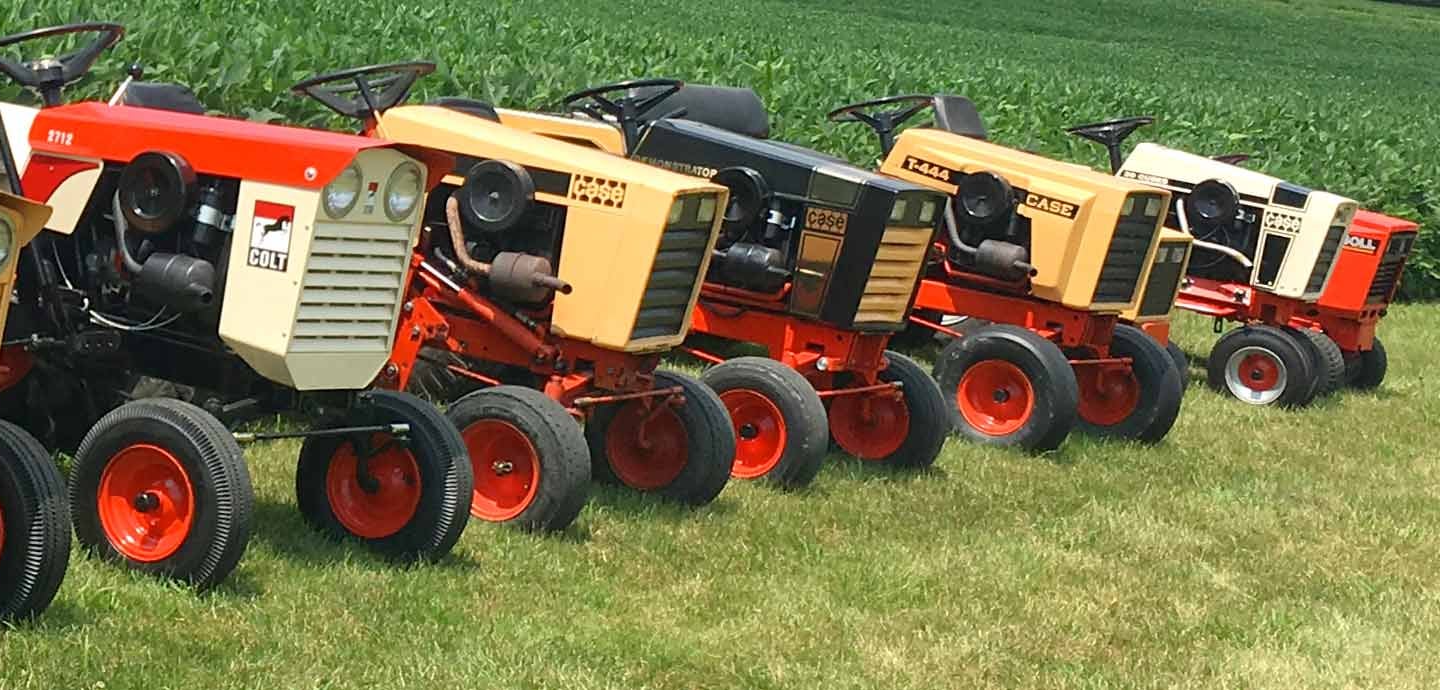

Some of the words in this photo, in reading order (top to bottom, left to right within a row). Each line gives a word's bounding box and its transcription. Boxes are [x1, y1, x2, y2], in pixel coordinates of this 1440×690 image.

[908, 158, 950, 181] T-444
[574, 180, 624, 202] case
[1026, 194, 1074, 217] CASE
[808, 211, 845, 230] case
[249, 248, 288, 271] COLT
